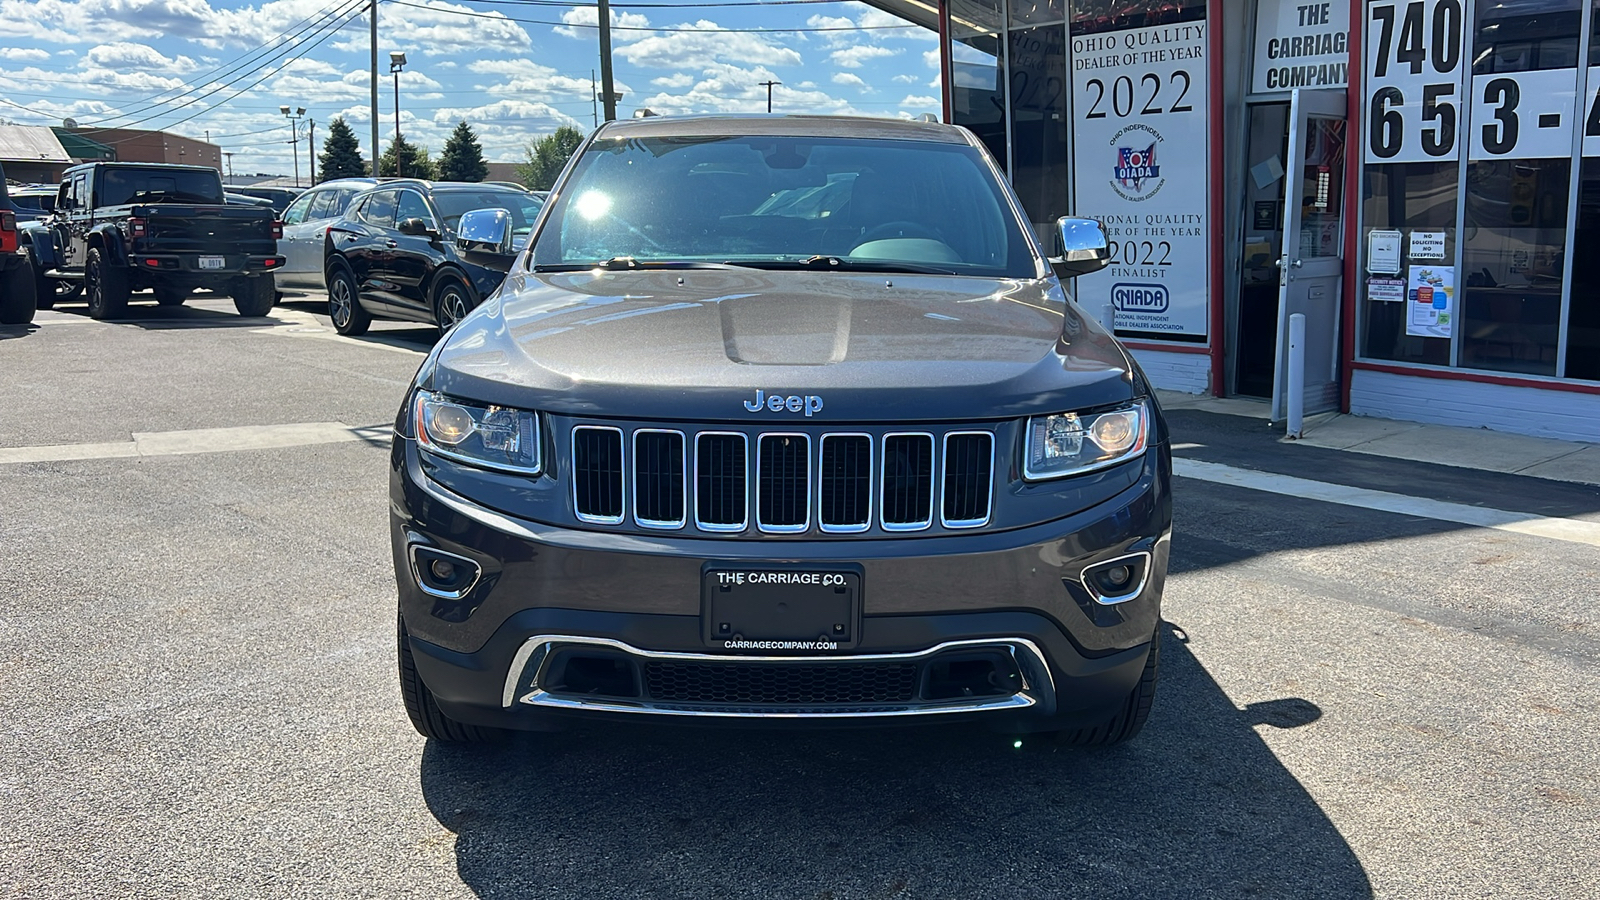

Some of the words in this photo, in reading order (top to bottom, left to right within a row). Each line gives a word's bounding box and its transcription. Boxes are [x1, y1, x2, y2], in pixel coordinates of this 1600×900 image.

[1297, 3, 1330, 27] THE
[1073, 36, 1116, 53] OHIO
[1124, 25, 1205, 50] QUALITY
[1268, 31, 1349, 60] CARRIAG
[1372, 0, 1461, 77] 740
[1076, 55, 1120, 70] DEALER
[1123, 53, 1138, 65] OF
[1141, 49, 1166, 64] THE
[1169, 45, 1202, 60] YEAR
[1266, 62, 1349, 89] COMPANY
[1085, 70, 1192, 119] 2022
[1109, 130, 1124, 146] OHIO
[1123, 124, 1164, 143] INDEPENDENT
[1120, 167, 1152, 178] OIADA
[1125, 227, 1139, 236] OF
[1144, 227, 1166, 236] THE
[1171, 227, 1201, 236] YEAR
[1145, 214, 1203, 225] QUALITY
[1110, 240, 1172, 265] 2022
[1111, 268, 1167, 278] FINALIST
[1115, 289, 1164, 308] NIADA
[743, 389, 823, 416] Jeep
[717, 572, 745, 584] THE
[748, 573, 820, 584] CARRIAGE
[823, 574, 847, 585] CO.
[724, 641, 837, 650] CARRIAGECOMPANY.COM
